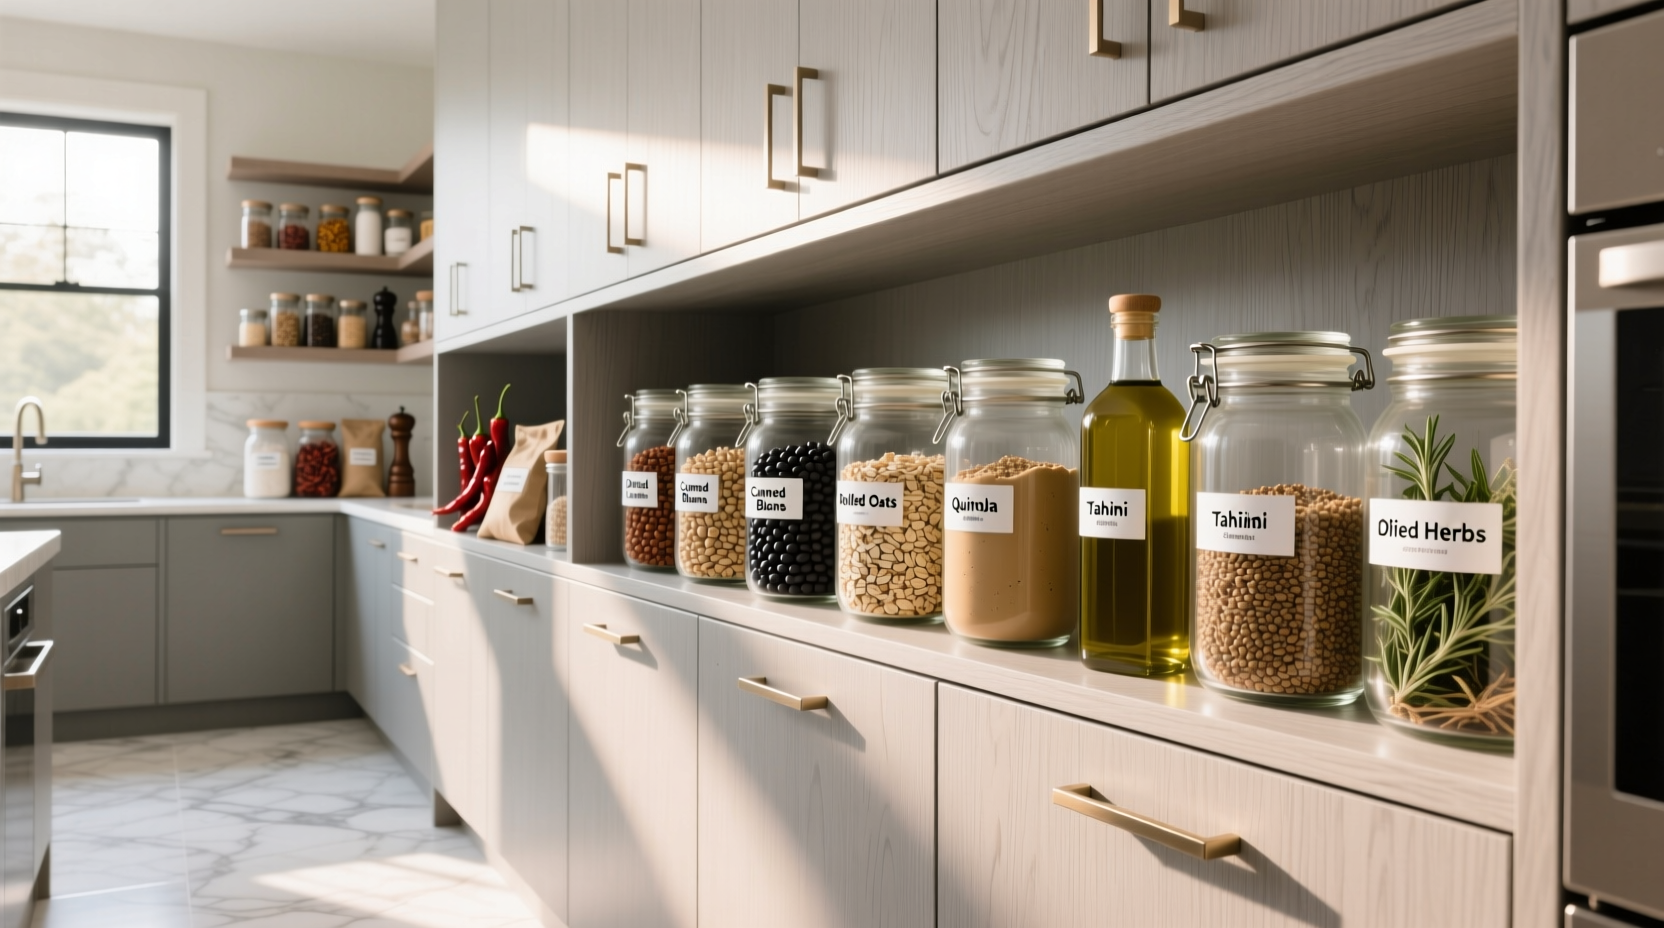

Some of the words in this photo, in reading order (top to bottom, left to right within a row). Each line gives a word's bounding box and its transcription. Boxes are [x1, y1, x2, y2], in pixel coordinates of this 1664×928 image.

[869, 494, 897, 508] Oats
[1086, 500, 1128, 517] Tahini
[1425, 522, 1487, 543] Herbs
